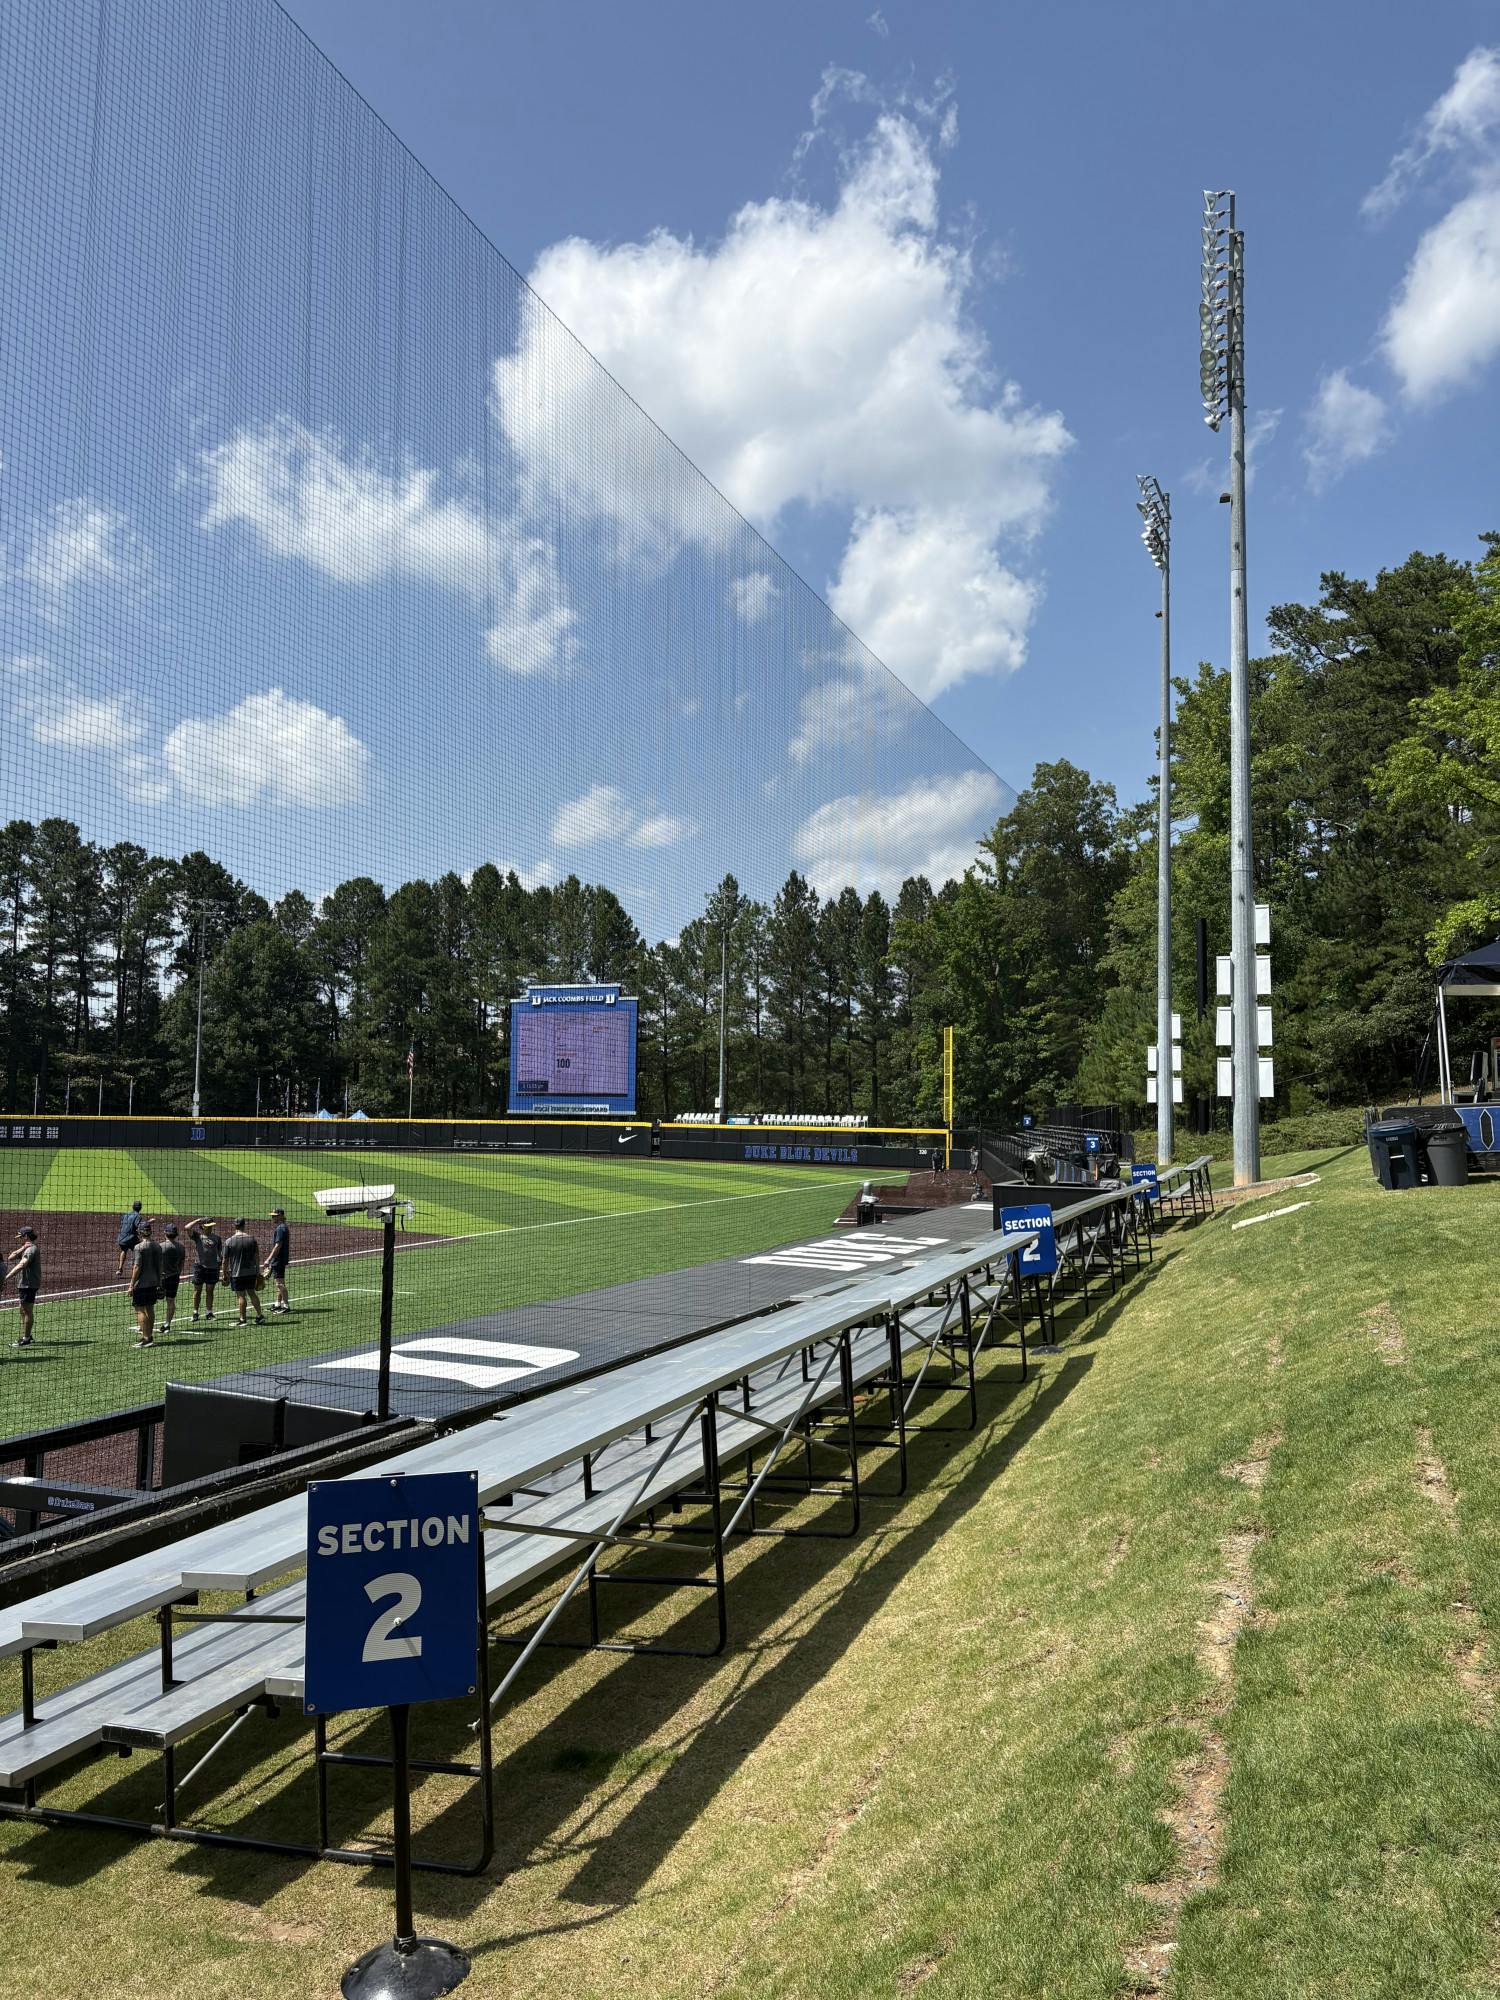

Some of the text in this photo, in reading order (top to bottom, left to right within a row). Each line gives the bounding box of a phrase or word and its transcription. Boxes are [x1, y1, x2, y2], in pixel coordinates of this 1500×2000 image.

[558, 995, 584, 1003] COOMBS
[586, 994, 604, 1002] FIELD
[557, 1058, 571, 1068] 100
[1090, 1141, 1096, 1149] 3
[744, 1145, 858, 1162] DUKE BLUE DEVILS
[1004, 1216, 1051, 1231] SECTION
[737, 1232, 950, 1272] DUKE
[317, 1514, 469, 1556] SECTION
[361, 1572, 423, 1663] 2
